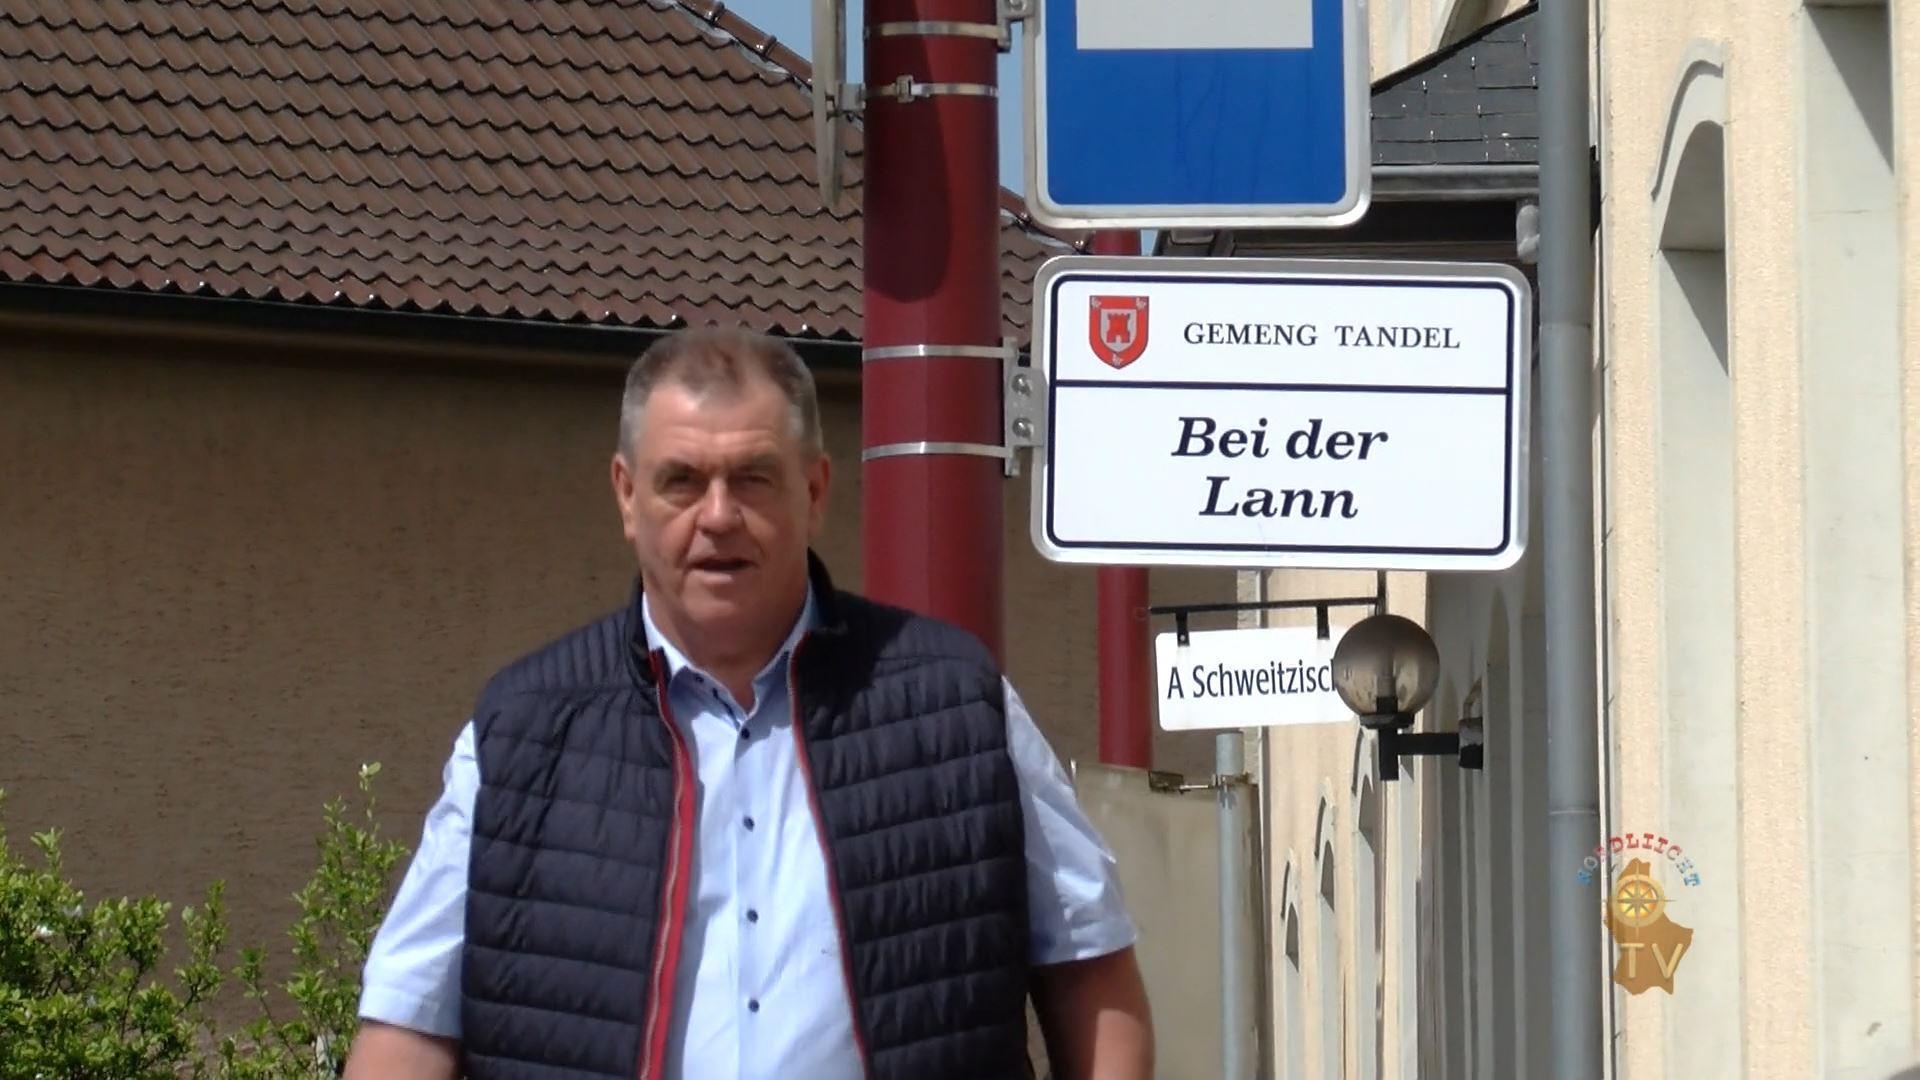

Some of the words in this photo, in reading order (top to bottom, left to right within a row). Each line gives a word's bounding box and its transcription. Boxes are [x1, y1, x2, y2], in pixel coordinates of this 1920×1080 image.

[1183, 322, 1318, 347] GEMENG
[1334, 325, 1461, 349] TANDEL
[1170, 416, 1270, 459] Bei
[1285, 418, 1389, 461] der
[1198, 475, 1359, 519] Lann
[1167, 666, 1185, 700] A
